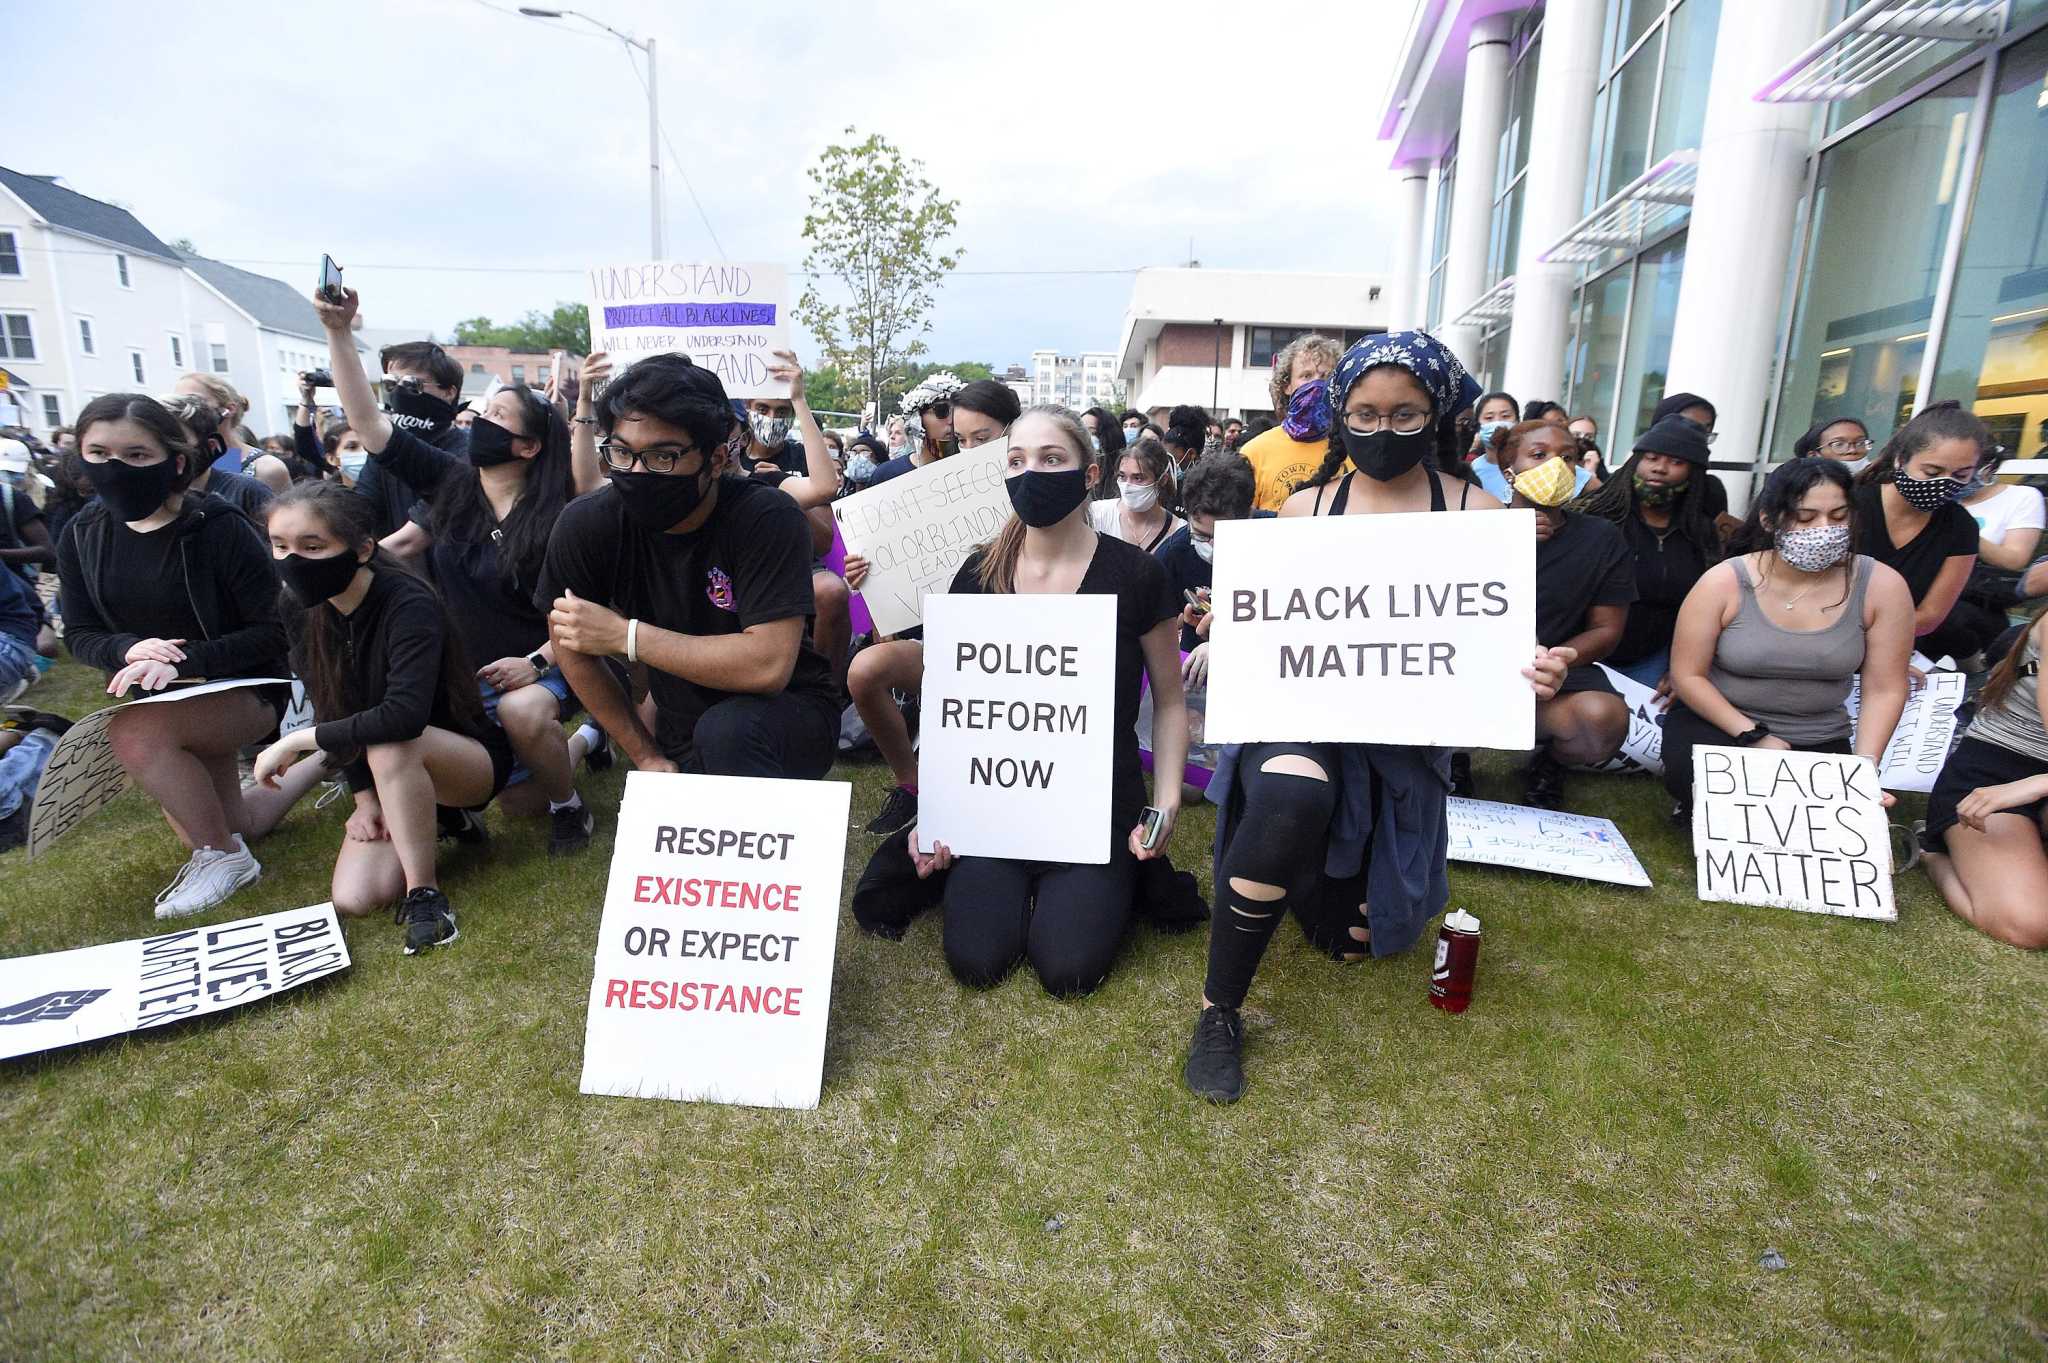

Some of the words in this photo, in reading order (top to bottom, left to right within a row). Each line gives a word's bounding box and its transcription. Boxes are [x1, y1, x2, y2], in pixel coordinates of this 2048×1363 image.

[601, 264, 751, 300] UNDERSTAND
[606, 306, 655, 327] PROTECT
[660, 306, 680, 323] ALL
[686, 306, 729, 323] BLACK
[602, 336, 632, 352] WILL
[636, 335, 676, 350] NEVER
[687, 335, 768, 348] UNDERSTAND
[695, 353, 768, 387] TAND
[1277, 464, 1306, 483] TOWN
[1232, 584, 1371, 622] BLACK
[1388, 581, 1509, 618] LIVES
[956, 642, 1079, 677] POLICE
[1279, 642, 1456, 679] MATTER
[941, 698, 1087, 735] REFORM
[1915, 696, 1958, 774] UNDERSTAND
[969, 757, 1054, 789] NOW
[1704, 752, 1872, 801] BLACK
[654, 825, 795, 861] RESPECT
[1705, 800, 1869, 858] LIVES
[633, 875, 802, 912] EXISTENCE
[1706, 849, 1882, 908] MATTER
[206, 922, 272, 1003] LIVES
[273, 917, 343, 989] BLACK
[624, 926, 670, 958] OR
[680, 929, 799, 962] EXPECT
[137, 930, 201, 1029] MATTER
[604, 979, 803, 1016] RESISTANCE
